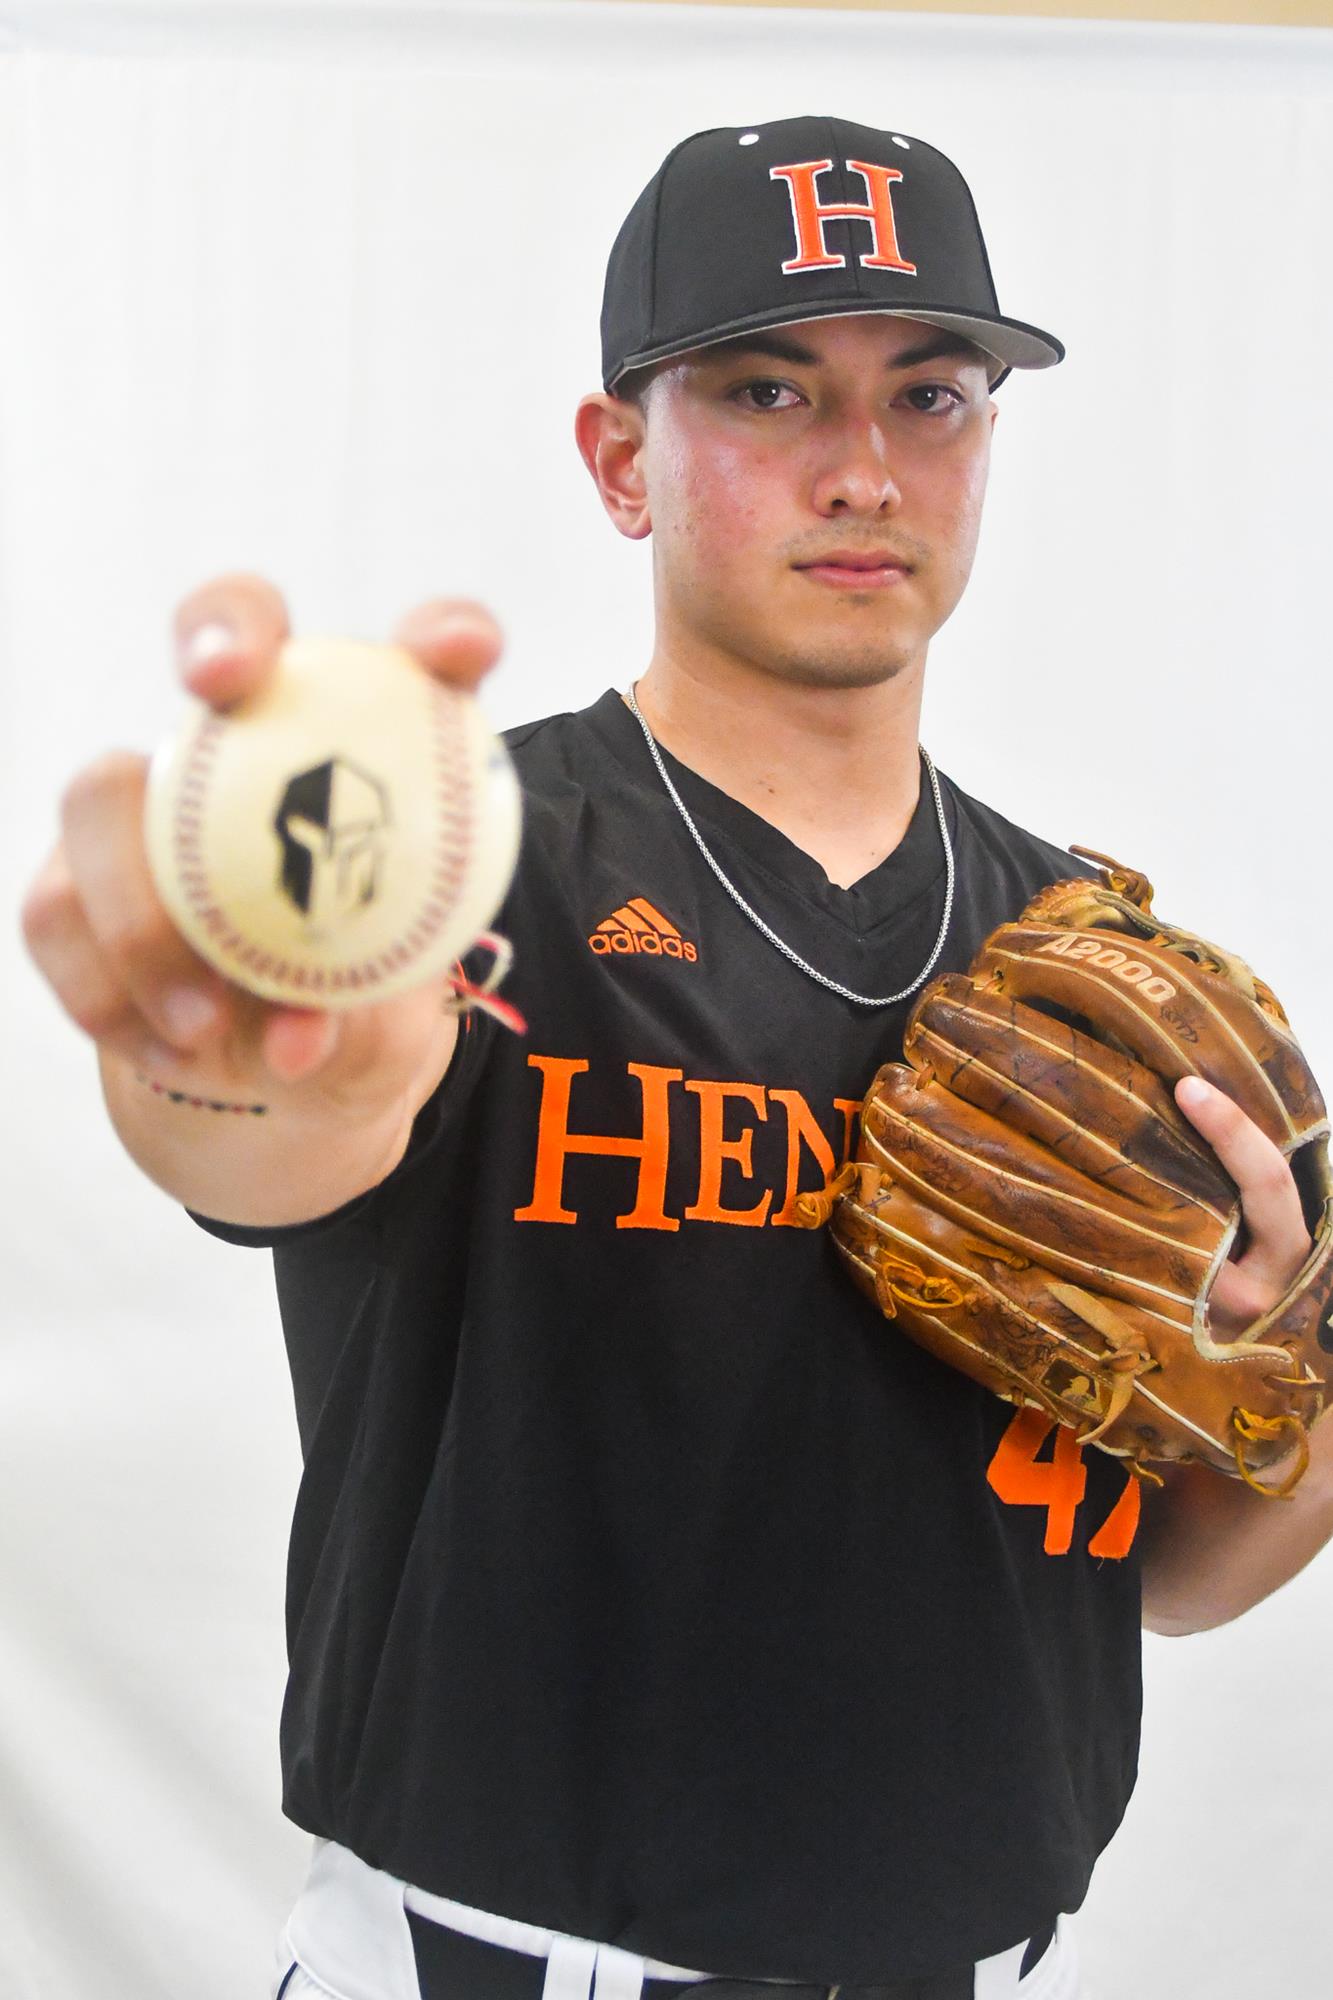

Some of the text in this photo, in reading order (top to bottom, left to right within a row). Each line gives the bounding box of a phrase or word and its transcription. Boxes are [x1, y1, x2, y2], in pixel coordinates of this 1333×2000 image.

[769, 158, 917, 276] H
[588, 928, 697, 963] adidas
[1037, 934, 1177, 1004] A2000
